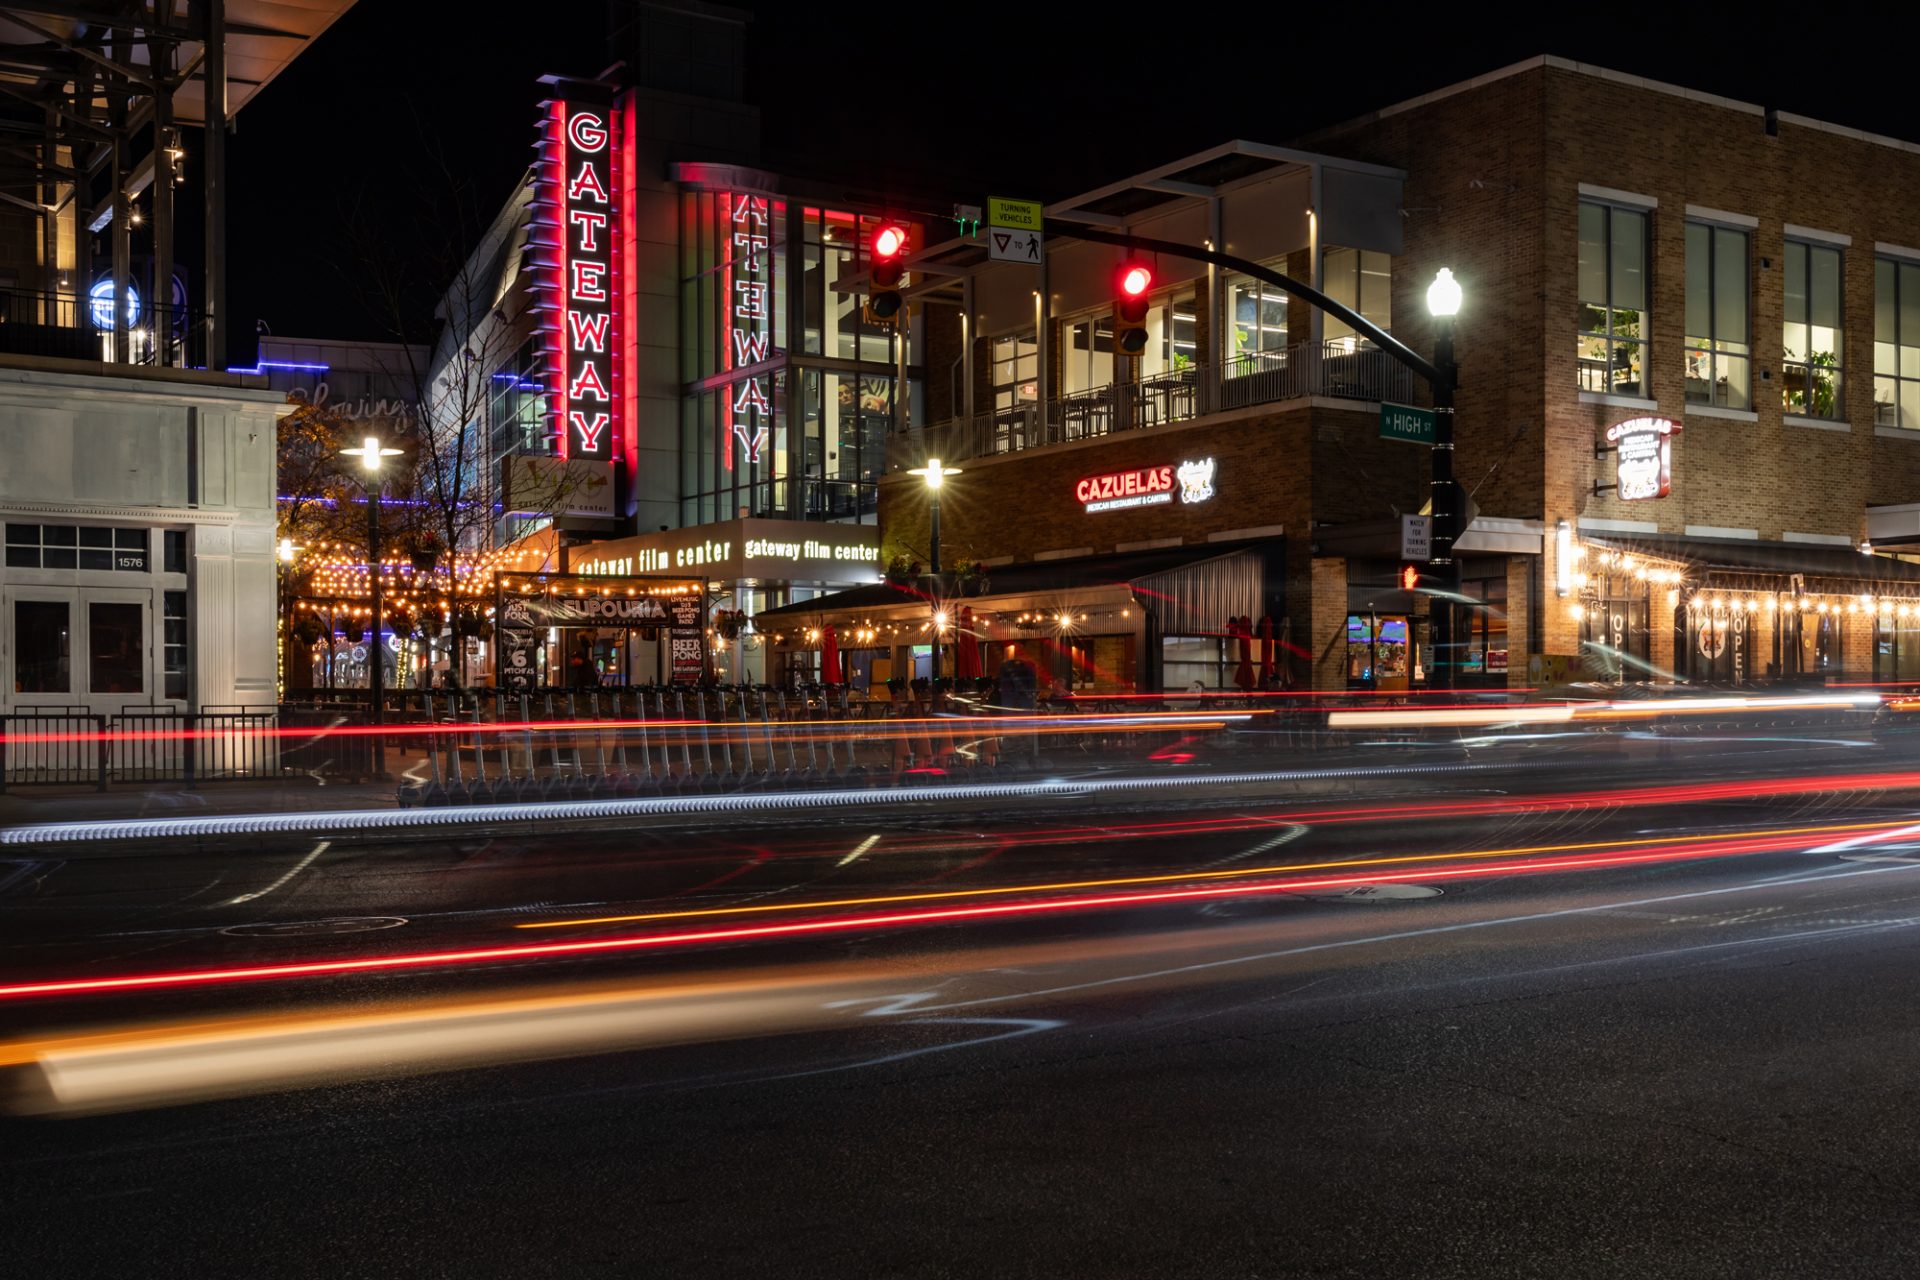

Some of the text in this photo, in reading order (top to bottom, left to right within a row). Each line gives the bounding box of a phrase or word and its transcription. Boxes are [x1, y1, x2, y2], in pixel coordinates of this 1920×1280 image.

[1000, 203, 1031, 214] TURNING
[999, 213, 1033, 225] VEHICLES
[1014, 241, 1023, 249] TO
[567, 111, 610, 453] GATEWAY
[1385, 413, 1432, 434] N HIGH ST
[1606, 417, 1672, 441] CAZUELAS
[1077, 467, 1172, 501] CAZUELAS
[579, 504, 608, 513] center
[1110, 497, 1142, 510] RESTAURANT
[1412, 529, 1422, 537] FOR
[1406, 538, 1427, 546] TURNING
[744, 539, 880, 561] gateway film center
[1406, 548, 1428, 556] VEHICLES
[118, 557, 143, 568] 1576
[578, 539, 731, 575] gateway film center
[563, 600, 668, 618] EUPOURIA
[673, 639, 701, 651] BEER
[673, 650, 702, 660] PONG
[1734, 618, 1743, 686] OPEN
